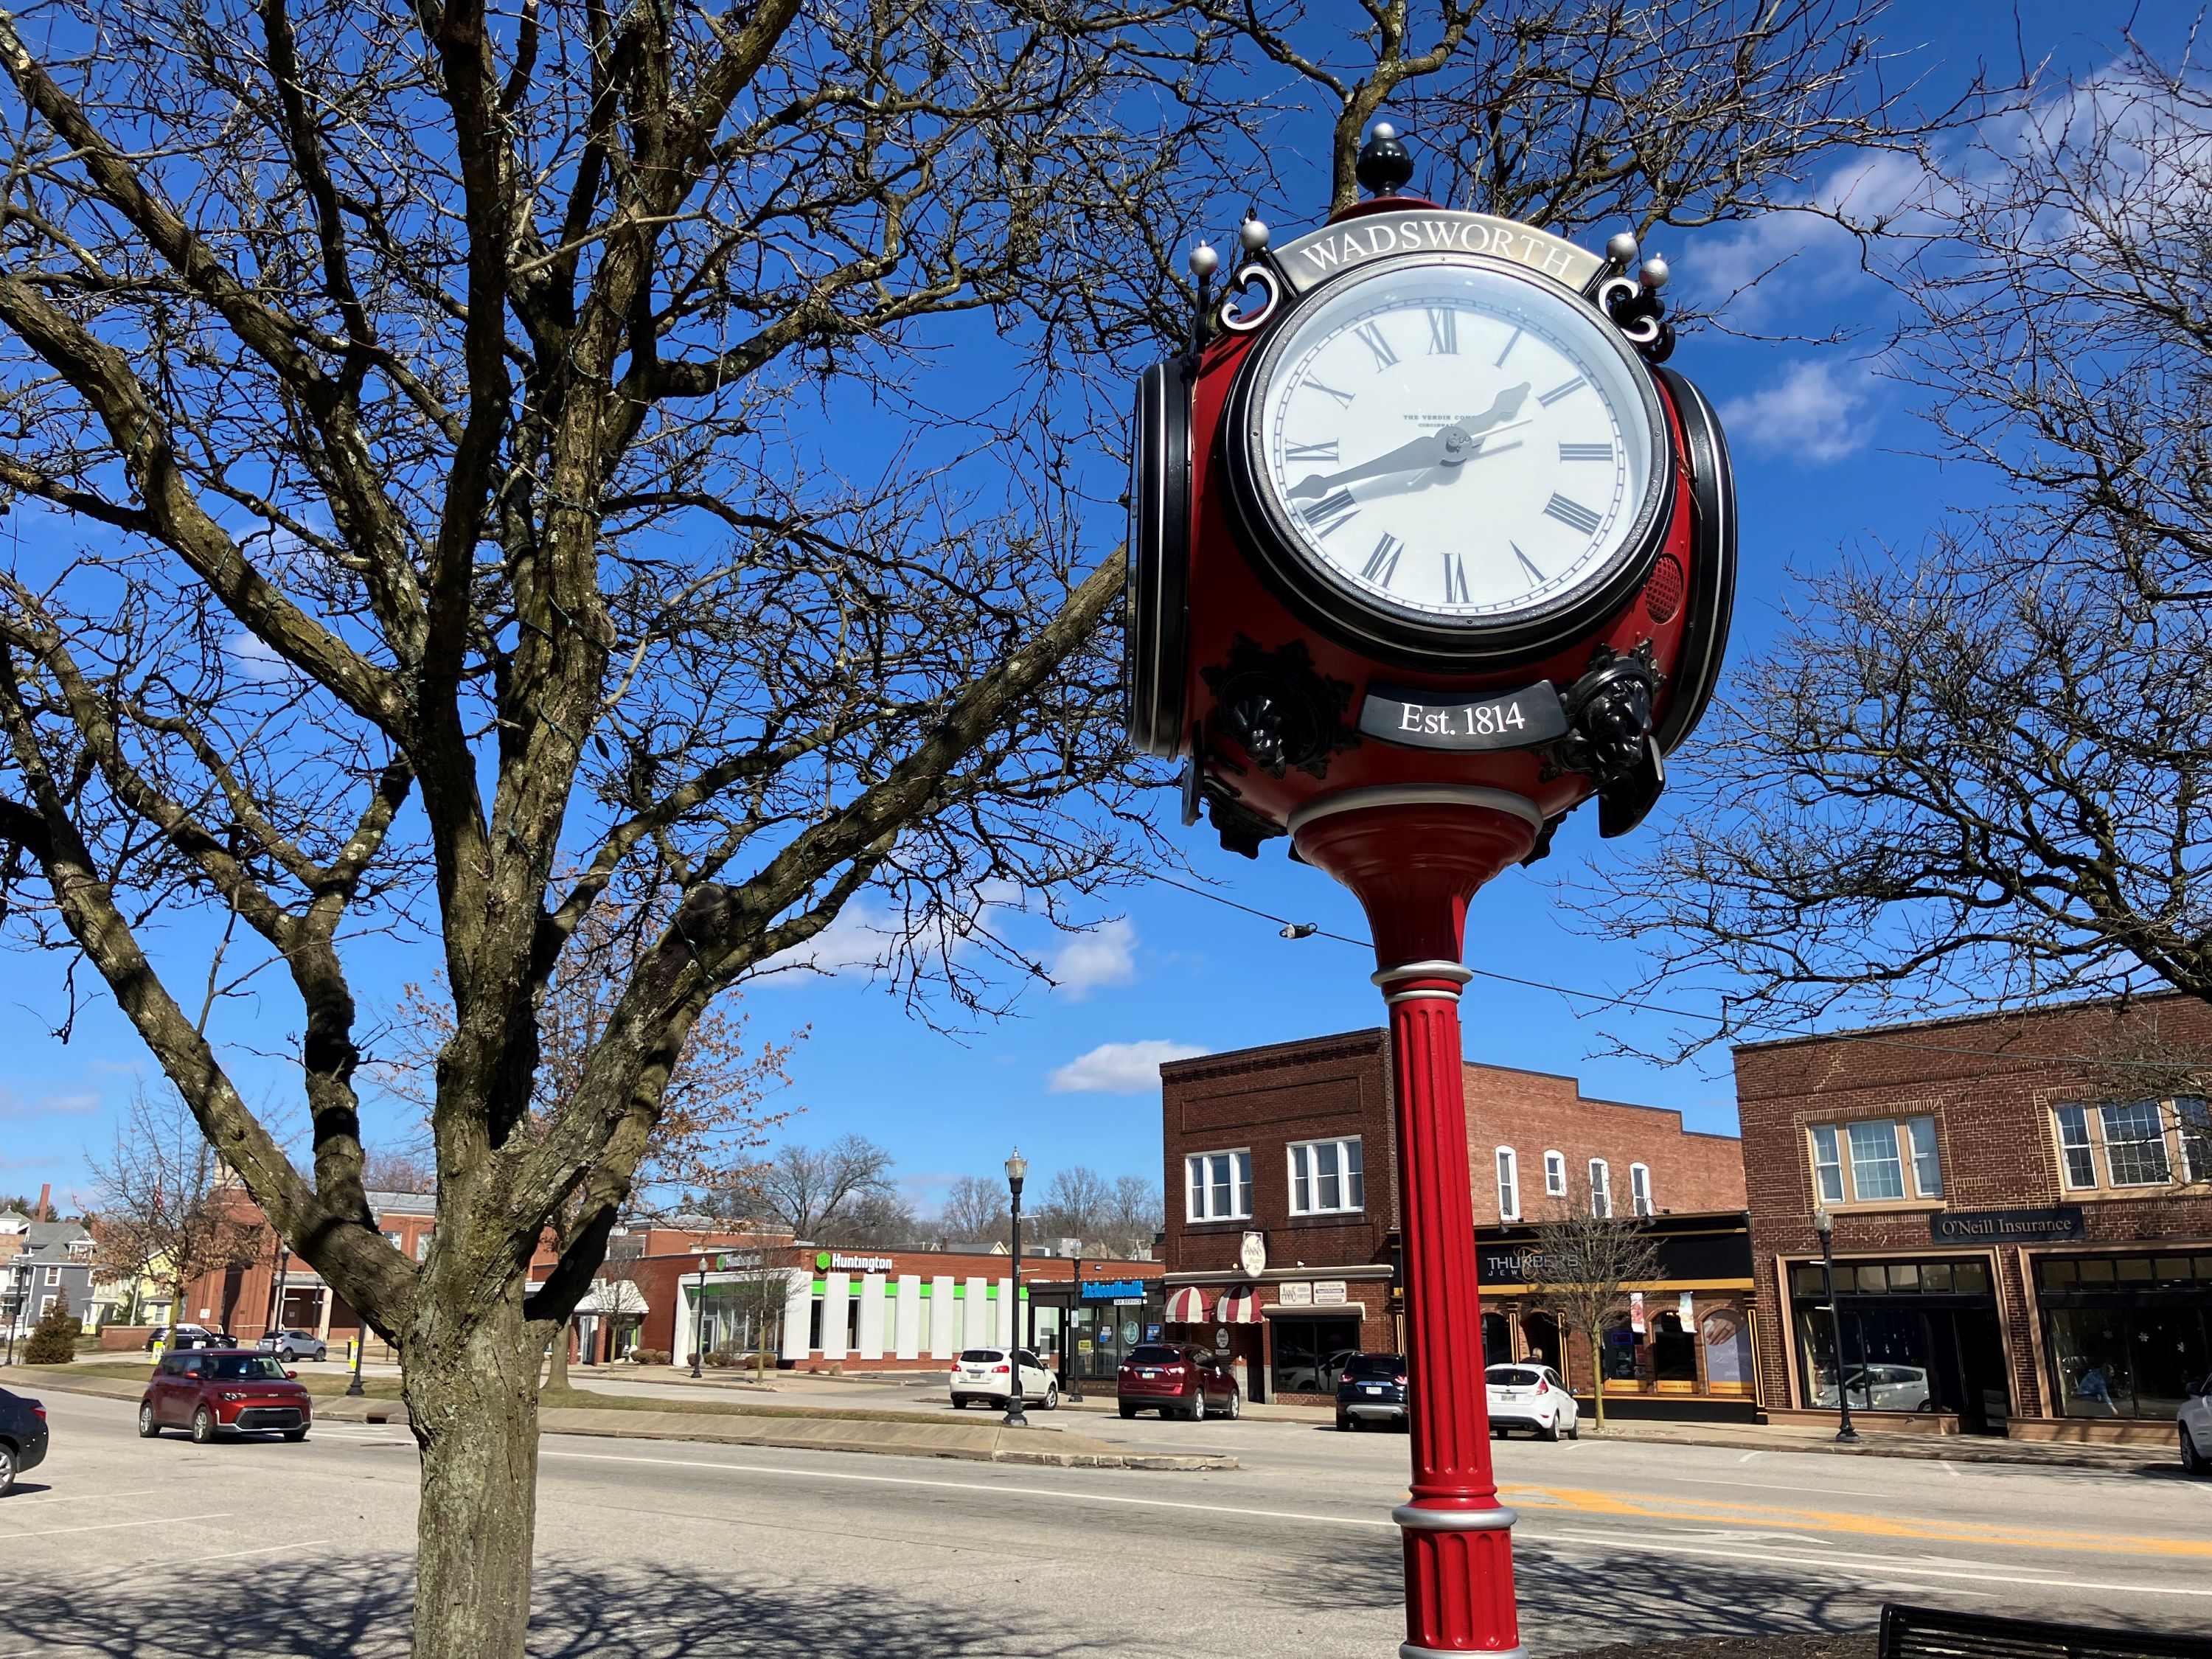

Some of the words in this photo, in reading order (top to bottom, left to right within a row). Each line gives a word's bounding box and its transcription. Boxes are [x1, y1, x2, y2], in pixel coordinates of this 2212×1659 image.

[1299, 220, 1576, 279] WADSWORTH
[1351, 319, 1402, 374] XI
[1424, 307, 1461, 355] XII
[1492, 325, 1525, 369] I
[1300, 370, 1356, 410] X
[1536, 373, 1588, 409] II
[1285, 438, 1339, 463] IX
[1558, 440, 1613, 463] III
[1300, 485, 1363, 542] VIII
[1357, 530, 1405, 590] VII
[1440, 552, 1474, 604] VI
[1509, 539, 1549, 588] V
[1397, 702, 1456, 736] Est.
[1464, 701, 1526, 735] 1814
[1941, 1219, 1994, 1236] O'Neill
[1997, 1218, 2072, 1234] Insurance
[831, 1253, 893, 1273] Huntington
